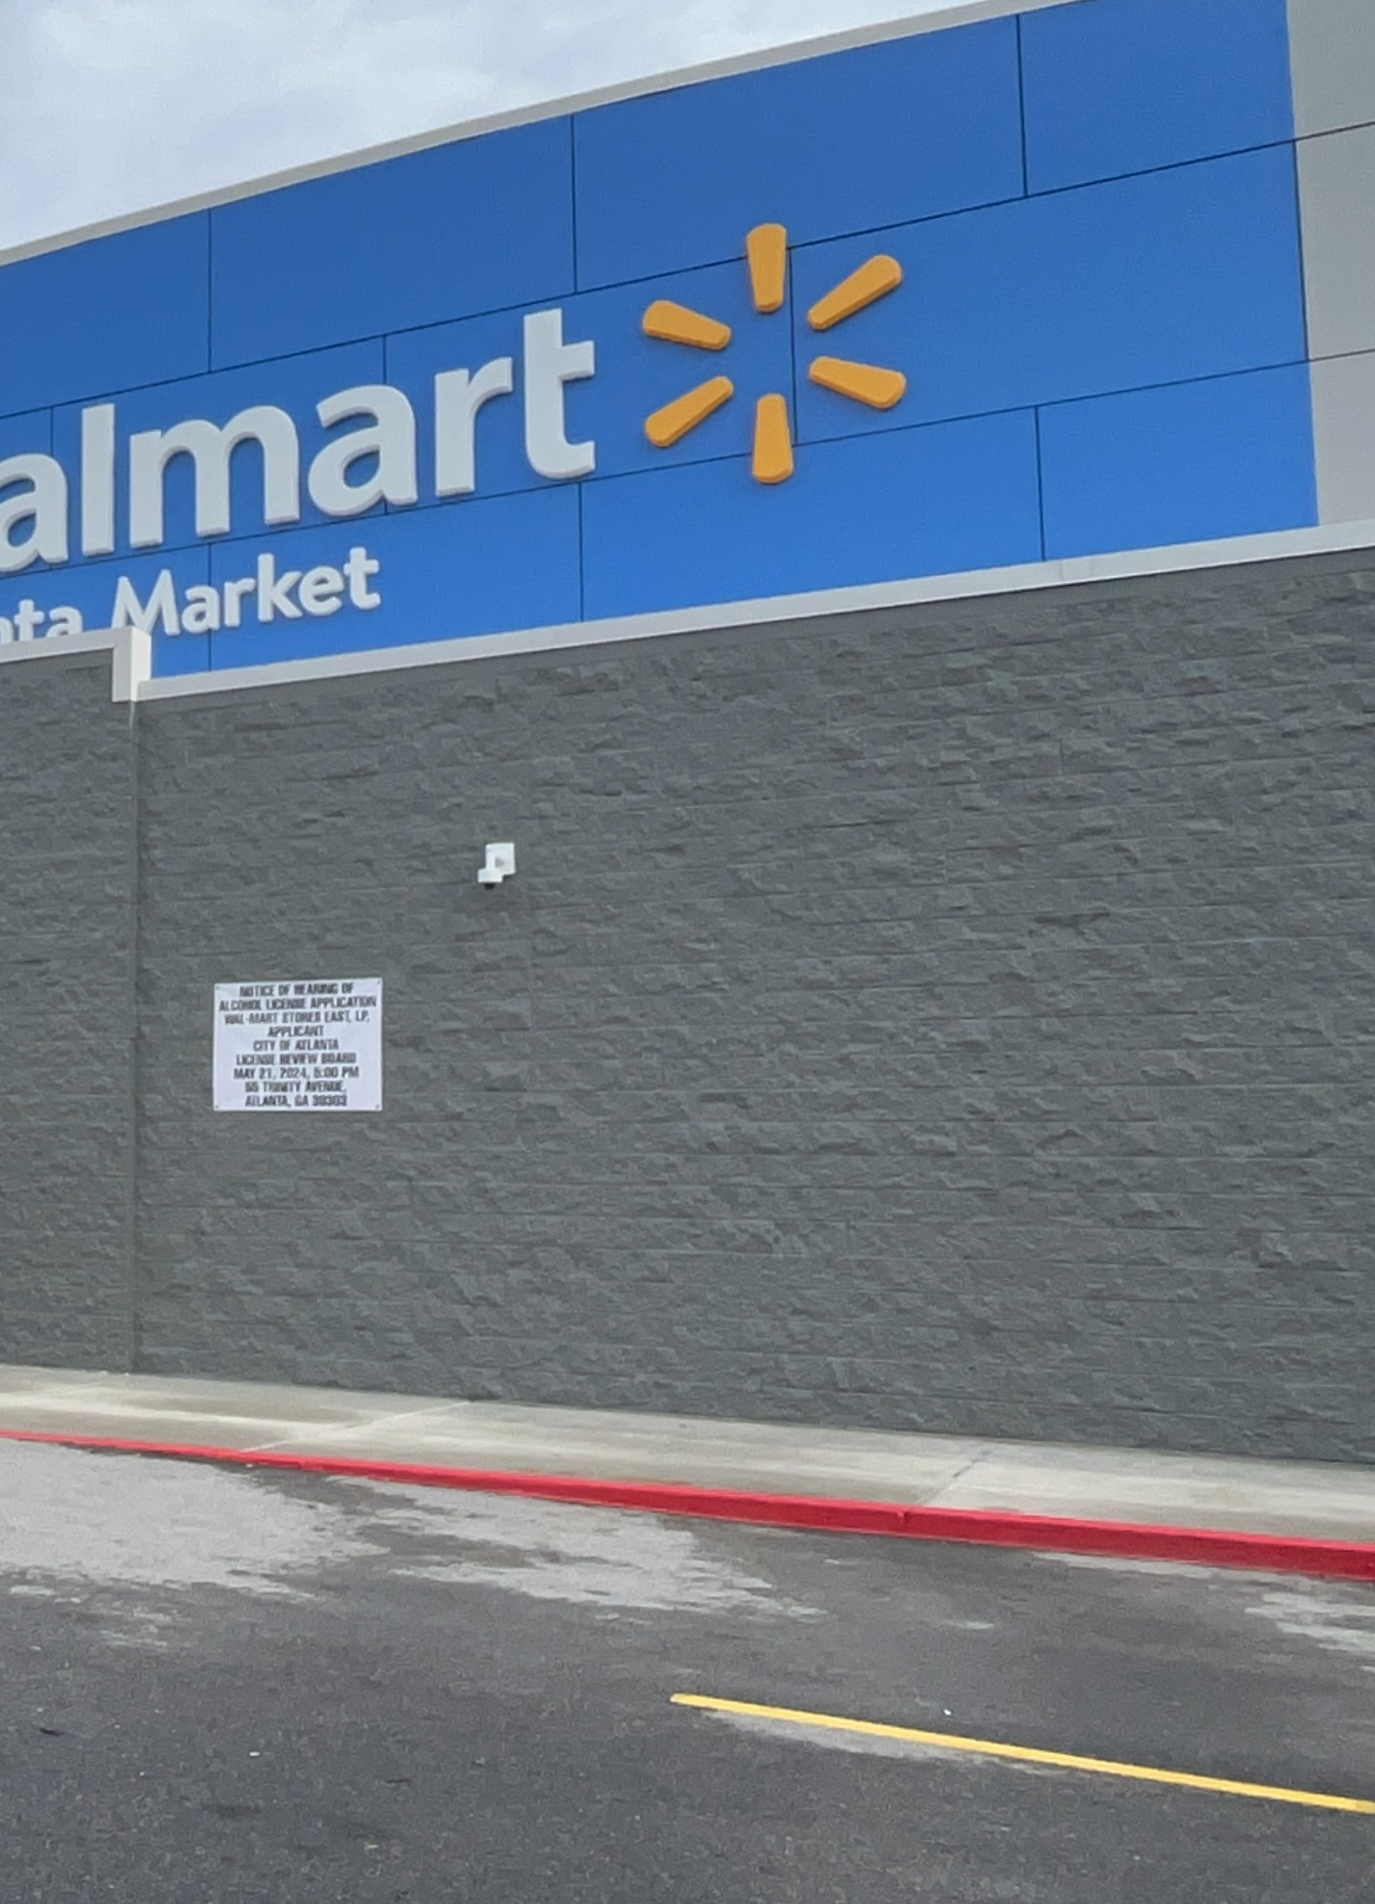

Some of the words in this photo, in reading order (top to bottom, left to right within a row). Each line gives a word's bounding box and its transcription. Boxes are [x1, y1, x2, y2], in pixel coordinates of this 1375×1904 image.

[111, 546, 381, 637] Market
[239, 984, 275, 997] NOTICE
[278, 983, 290, 996] OF
[341, 982, 354, 994] OF
[219, 999, 262, 1011] ALCOHOL
[266, 997, 306, 1010] LICENSE
[310, 995, 377, 1009] APPLICATION
[281, 1011, 321, 1024] STORES
[267, 1025, 324, 1037] APPLICANT
[253, 1040, 276, 1052] CITY
[279, 1040, 291, 1051] OF
[294, 1038, 339, 1051] ATLANTA
[236, 1054, 275, 1065] LICENSE
[280, 1053, 318, 1065] REVIEW
[321, 1052, 356, 1064] BOARD
[233, 1067, 256, 1079] MAY
[341, 1066, 359, 1078] PM
[295, 1094, 309, 1106] GA
